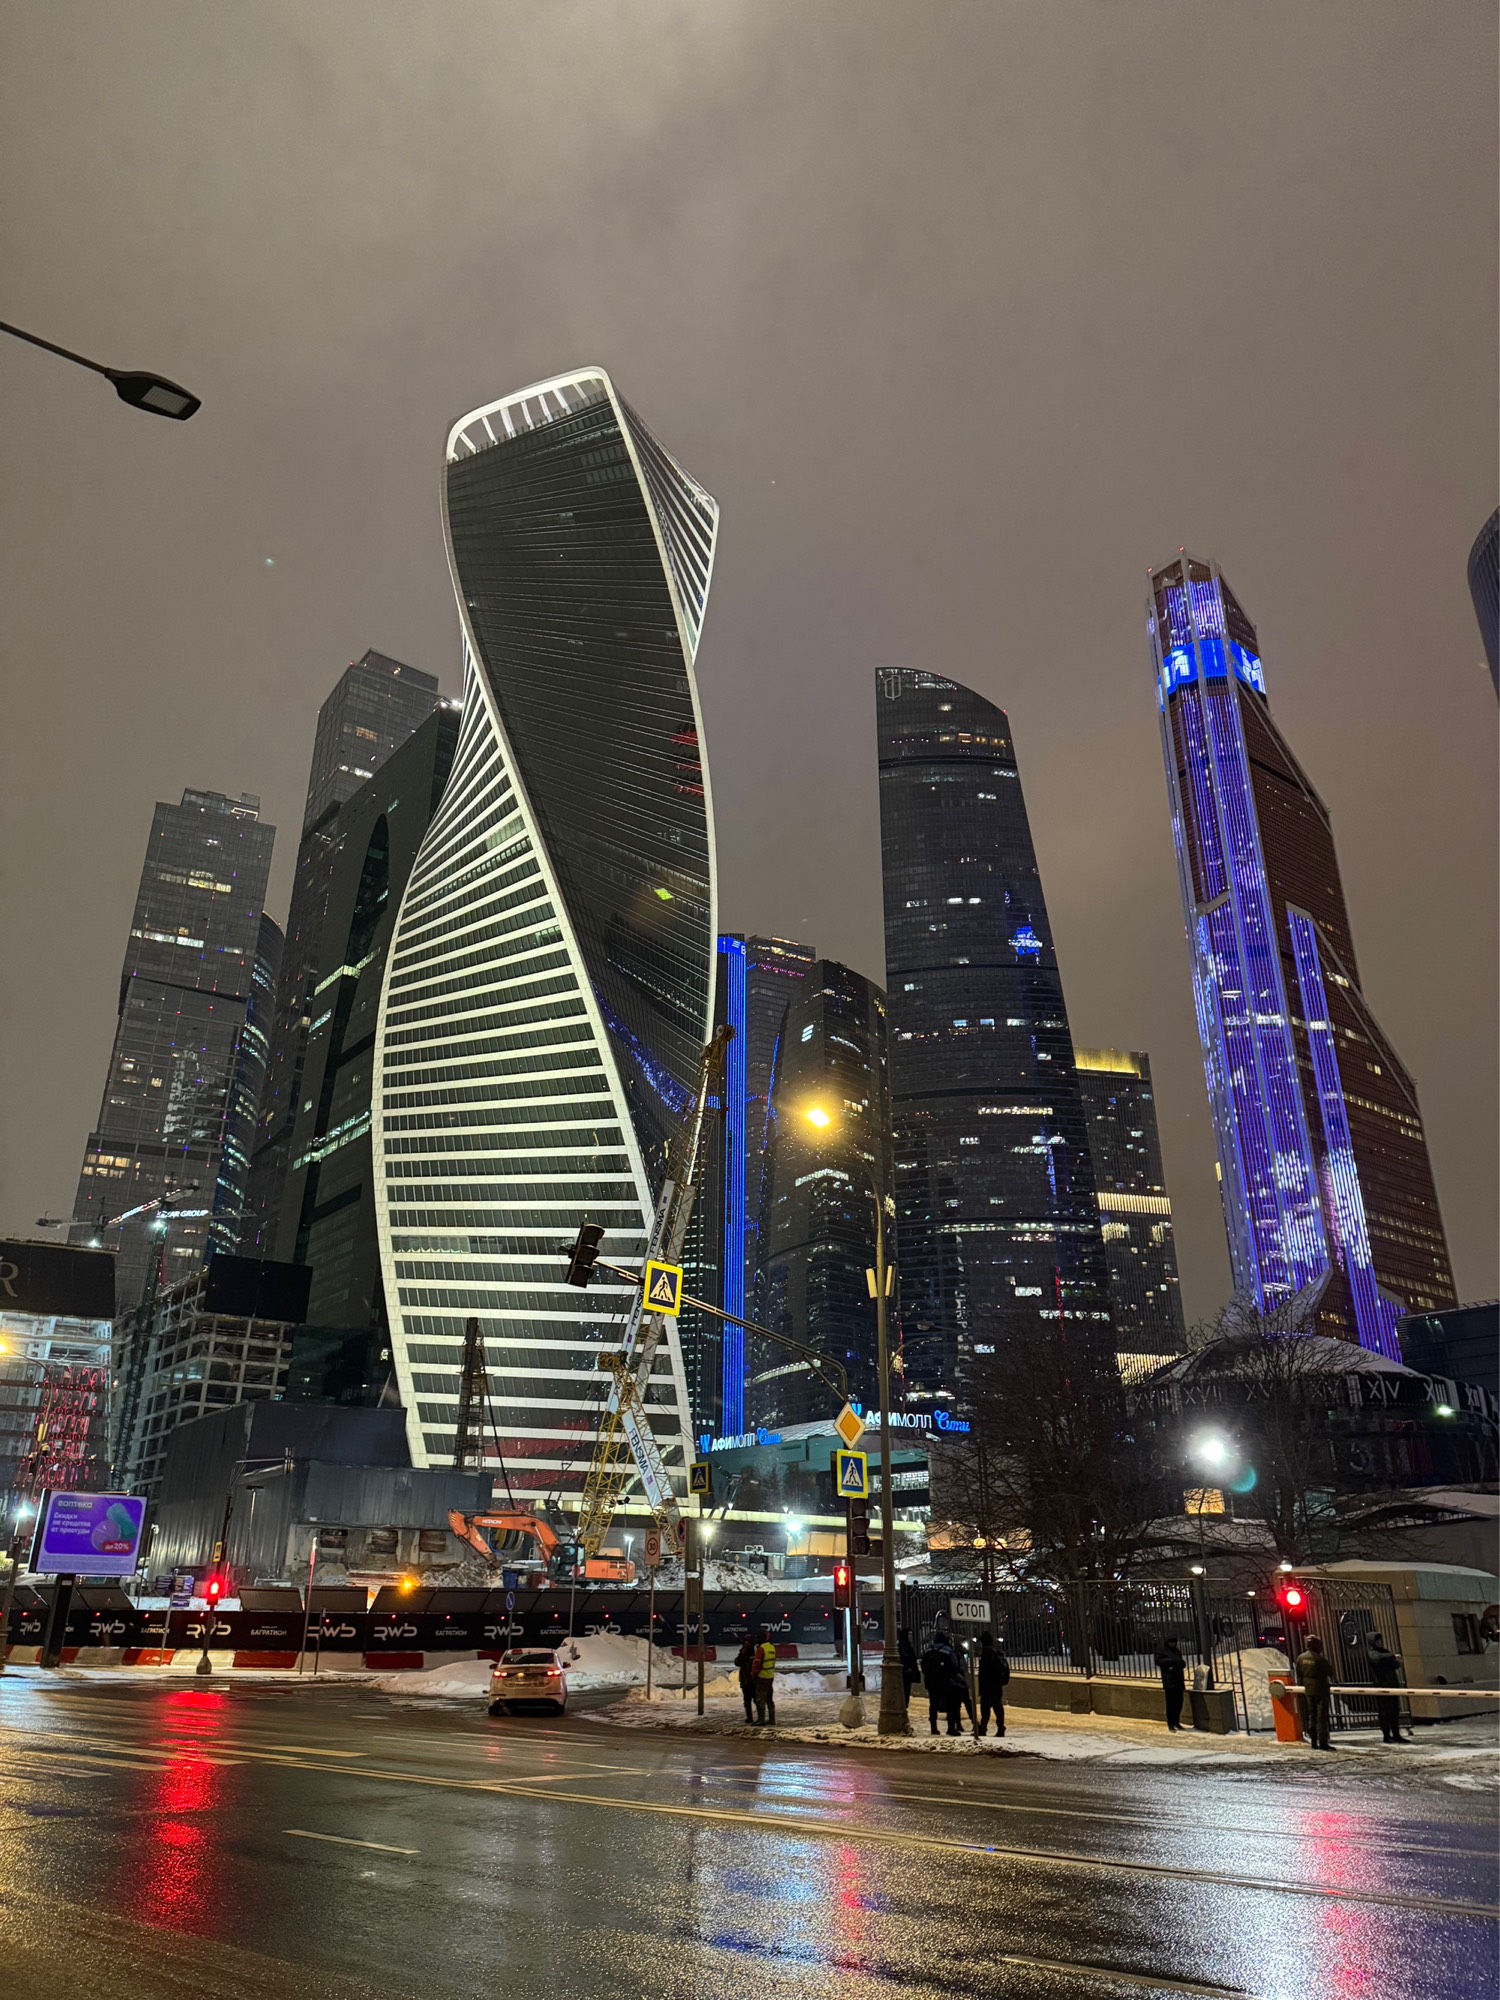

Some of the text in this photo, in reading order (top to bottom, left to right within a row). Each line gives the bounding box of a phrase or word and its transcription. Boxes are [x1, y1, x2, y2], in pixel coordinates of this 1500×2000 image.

[650, 1209, 666, 1254] FENSMA
[629, 1427, 648, 1476] FENSMA
[711, 1432, 756, 1452] АФИМОЛЛ
[956, 1602, 986, 1619] СТОП
[250, 1628, 288, 1637] БАГРАТИОН
